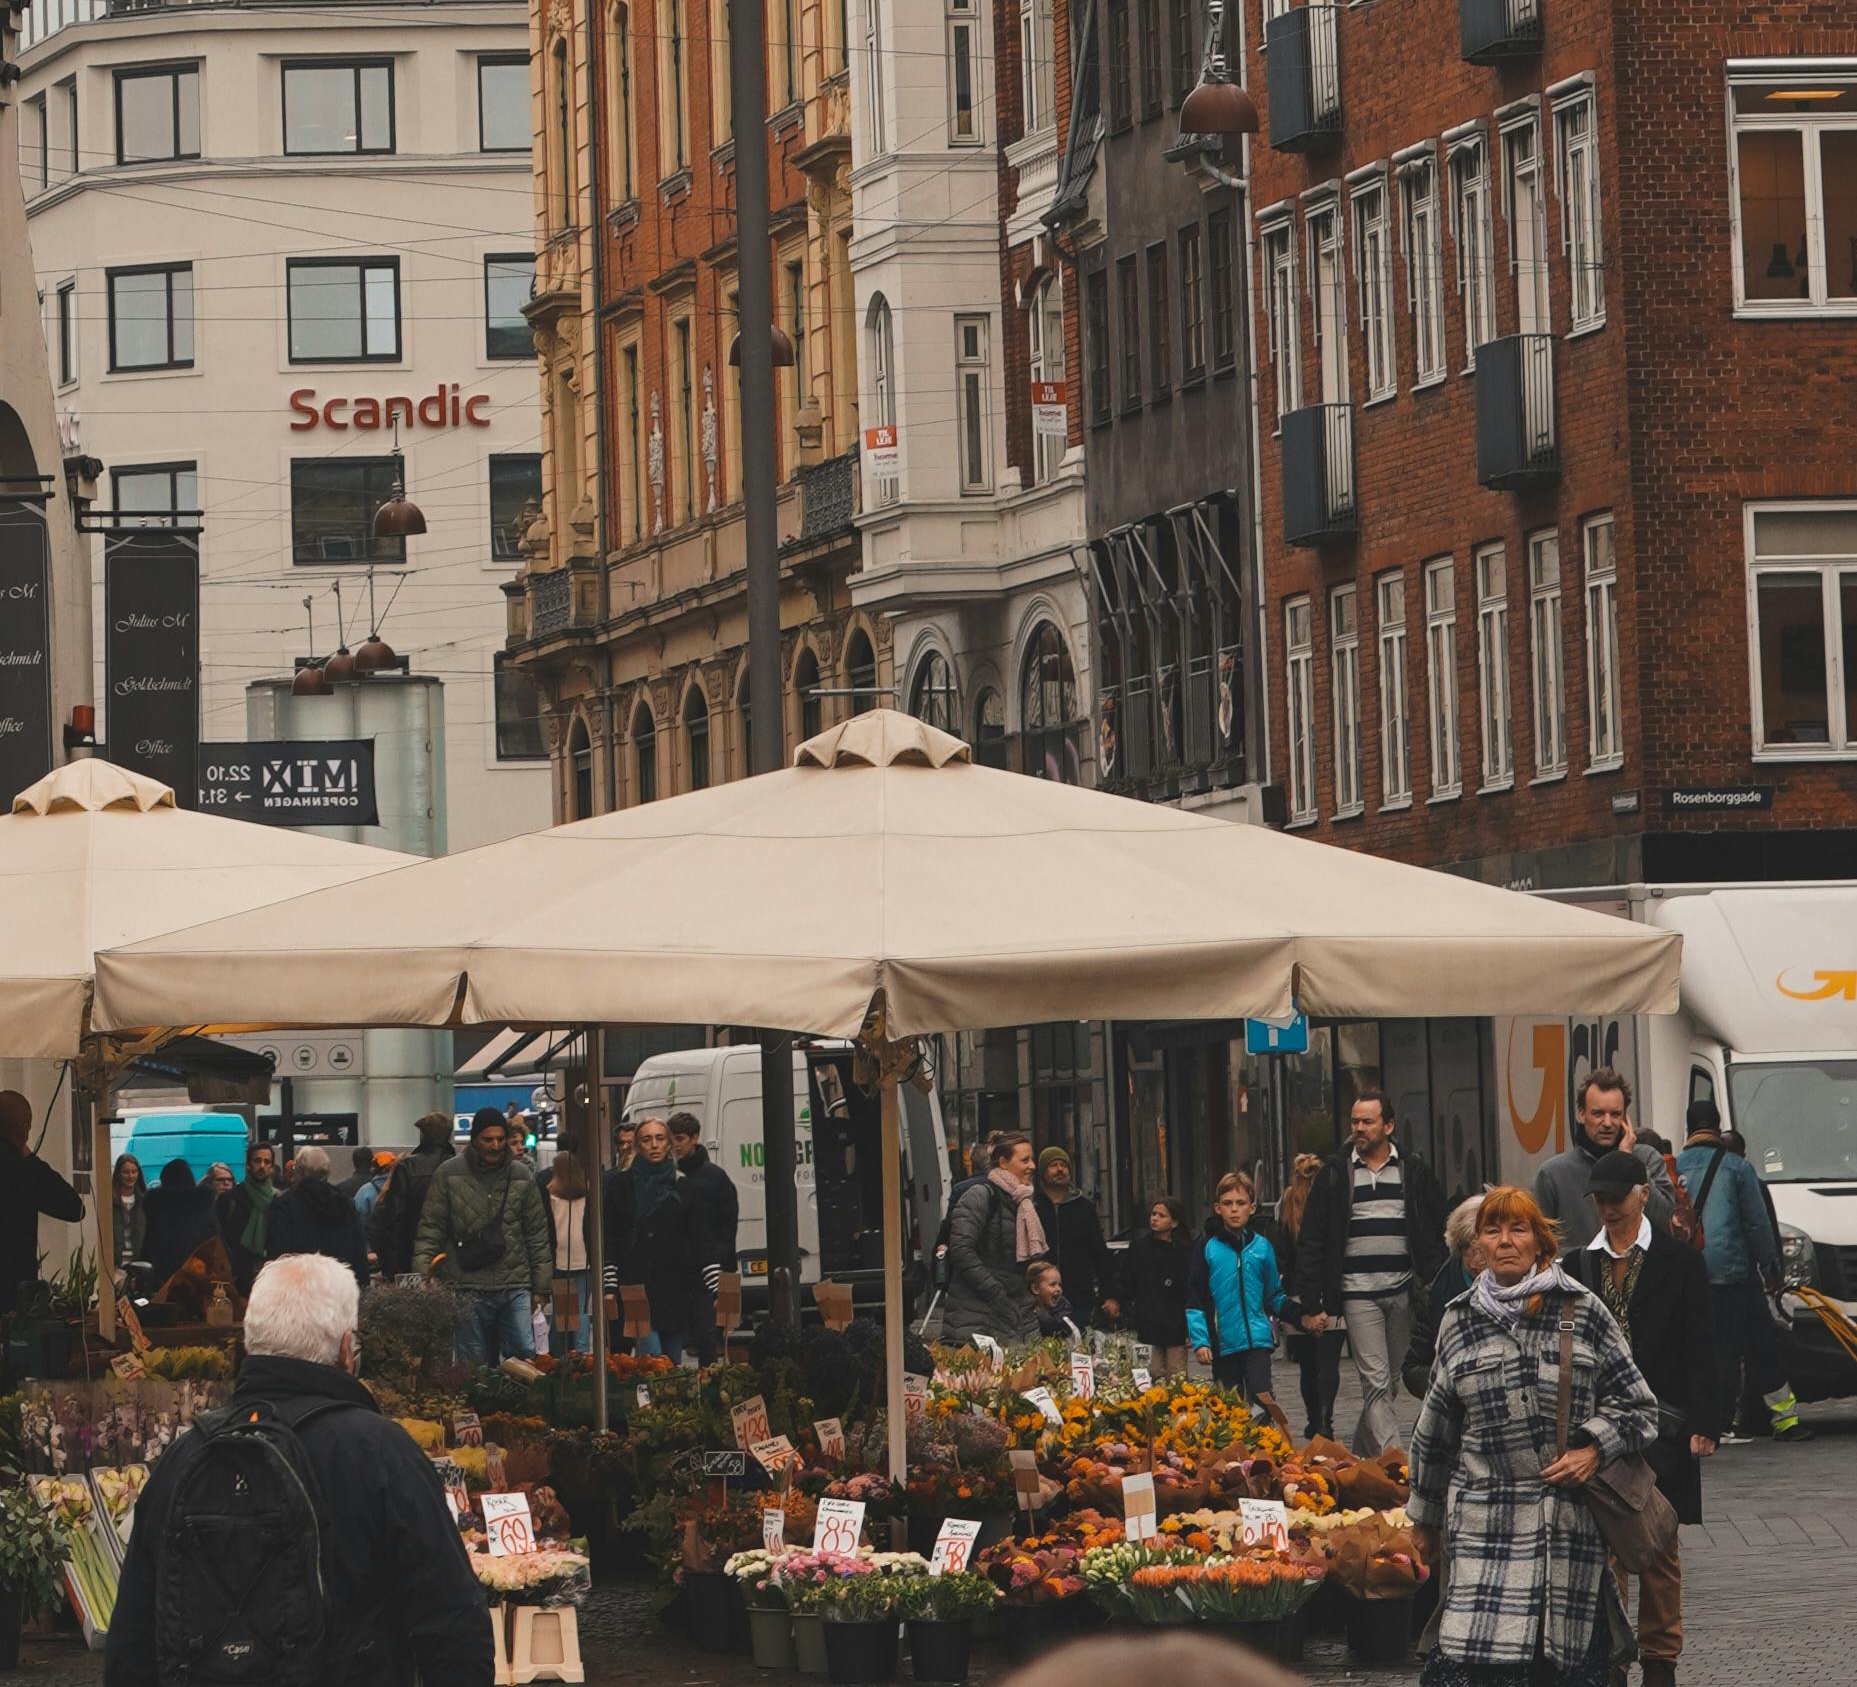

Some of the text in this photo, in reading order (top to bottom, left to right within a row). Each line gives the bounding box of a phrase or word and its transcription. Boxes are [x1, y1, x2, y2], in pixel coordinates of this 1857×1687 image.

[289, 383, 491, 431] Scandic
[115, 613, 158, 633] Julius
[114, 676, 192, 696] Goldschmidt
[135, 739, 174, 759] Office
[1673, 791, 1762, 805] Rosenborggade
[821, 1516, 857, 1553] 85
